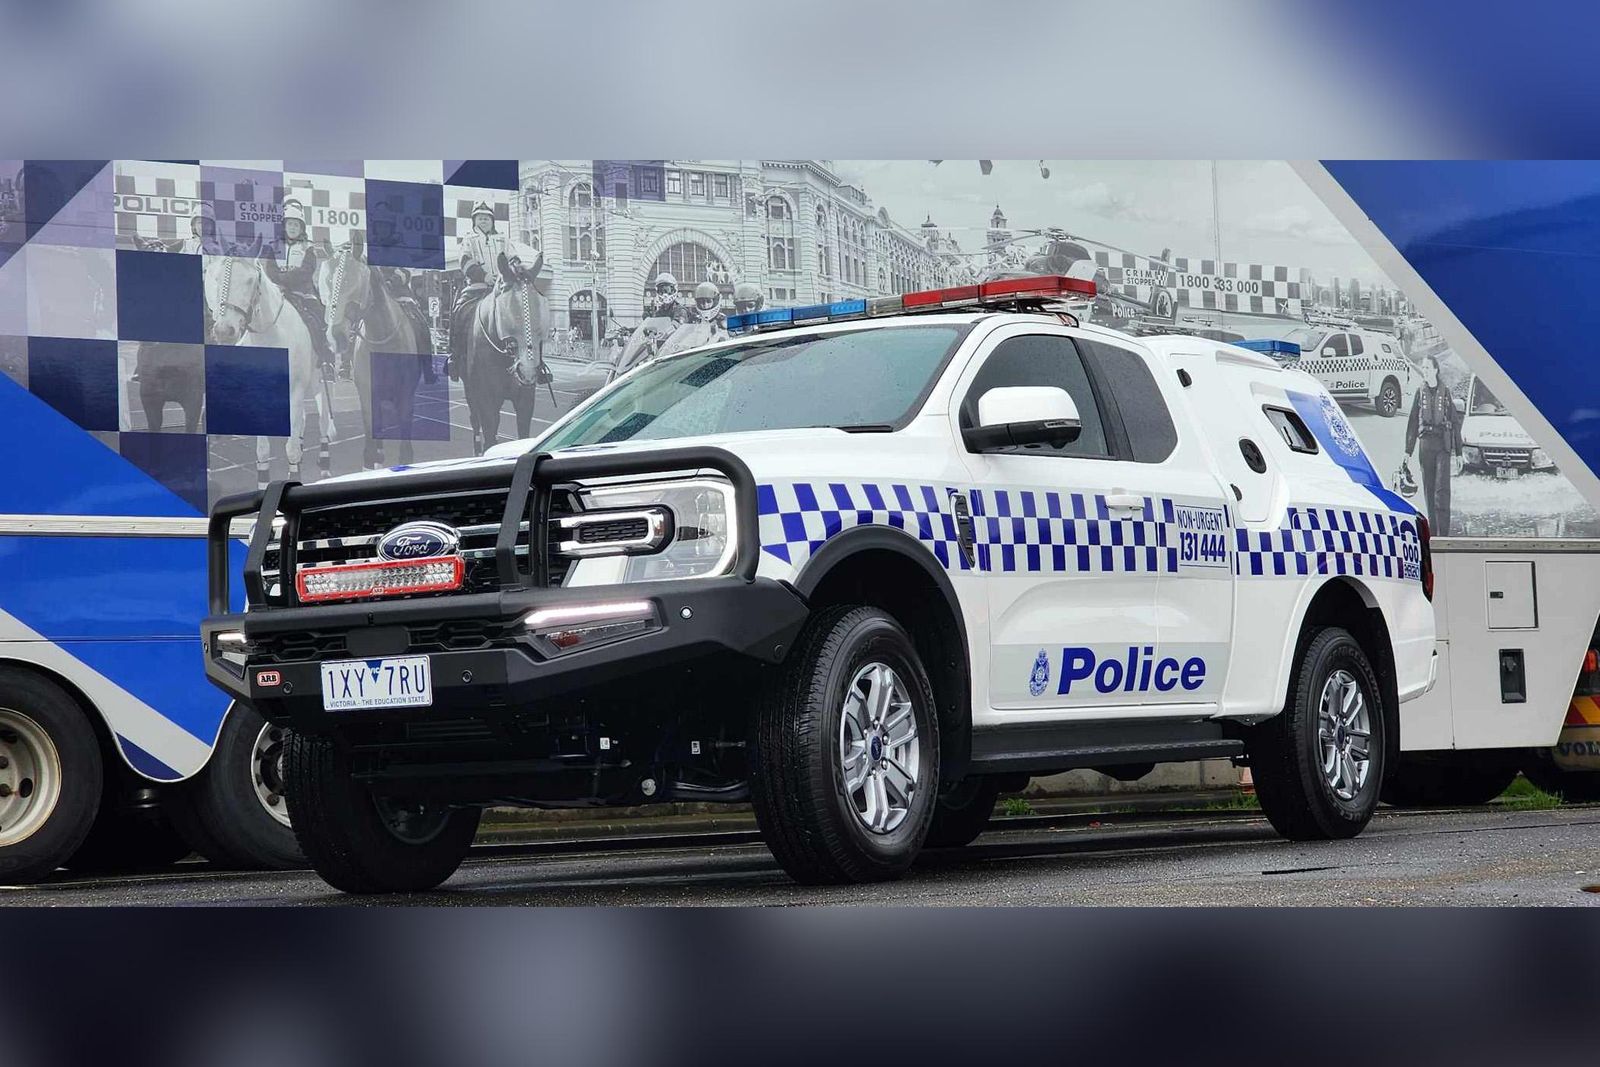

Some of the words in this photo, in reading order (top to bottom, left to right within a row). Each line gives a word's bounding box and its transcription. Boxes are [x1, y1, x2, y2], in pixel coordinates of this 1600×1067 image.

[317, 209, 360, 226] 1800
[1180, 274, 1210, 289] 1800
[1237, 280, 1259, 294] 000
[1335, 380, 1365, 389] Police
[1176, 509, 1224, 531] NON-URGENT
[392, 536, 431, 556] Ford
[1180, 532, 1198, 561] 131
[1200, 533, 1226, 562] 444
[1402, 543, 1419, 563] 000
[261, 674, 277, 683] ARB
[1057, 646, 1206, 695] Police
[328, 667, 365, 699] 1XY
[384, 664, 426, 695] 7RU
[330, 700, 357, 708] VICTORIA
[375, 697, 407, 706] EDUCATION
[408, 695, 425, 703] STATE
